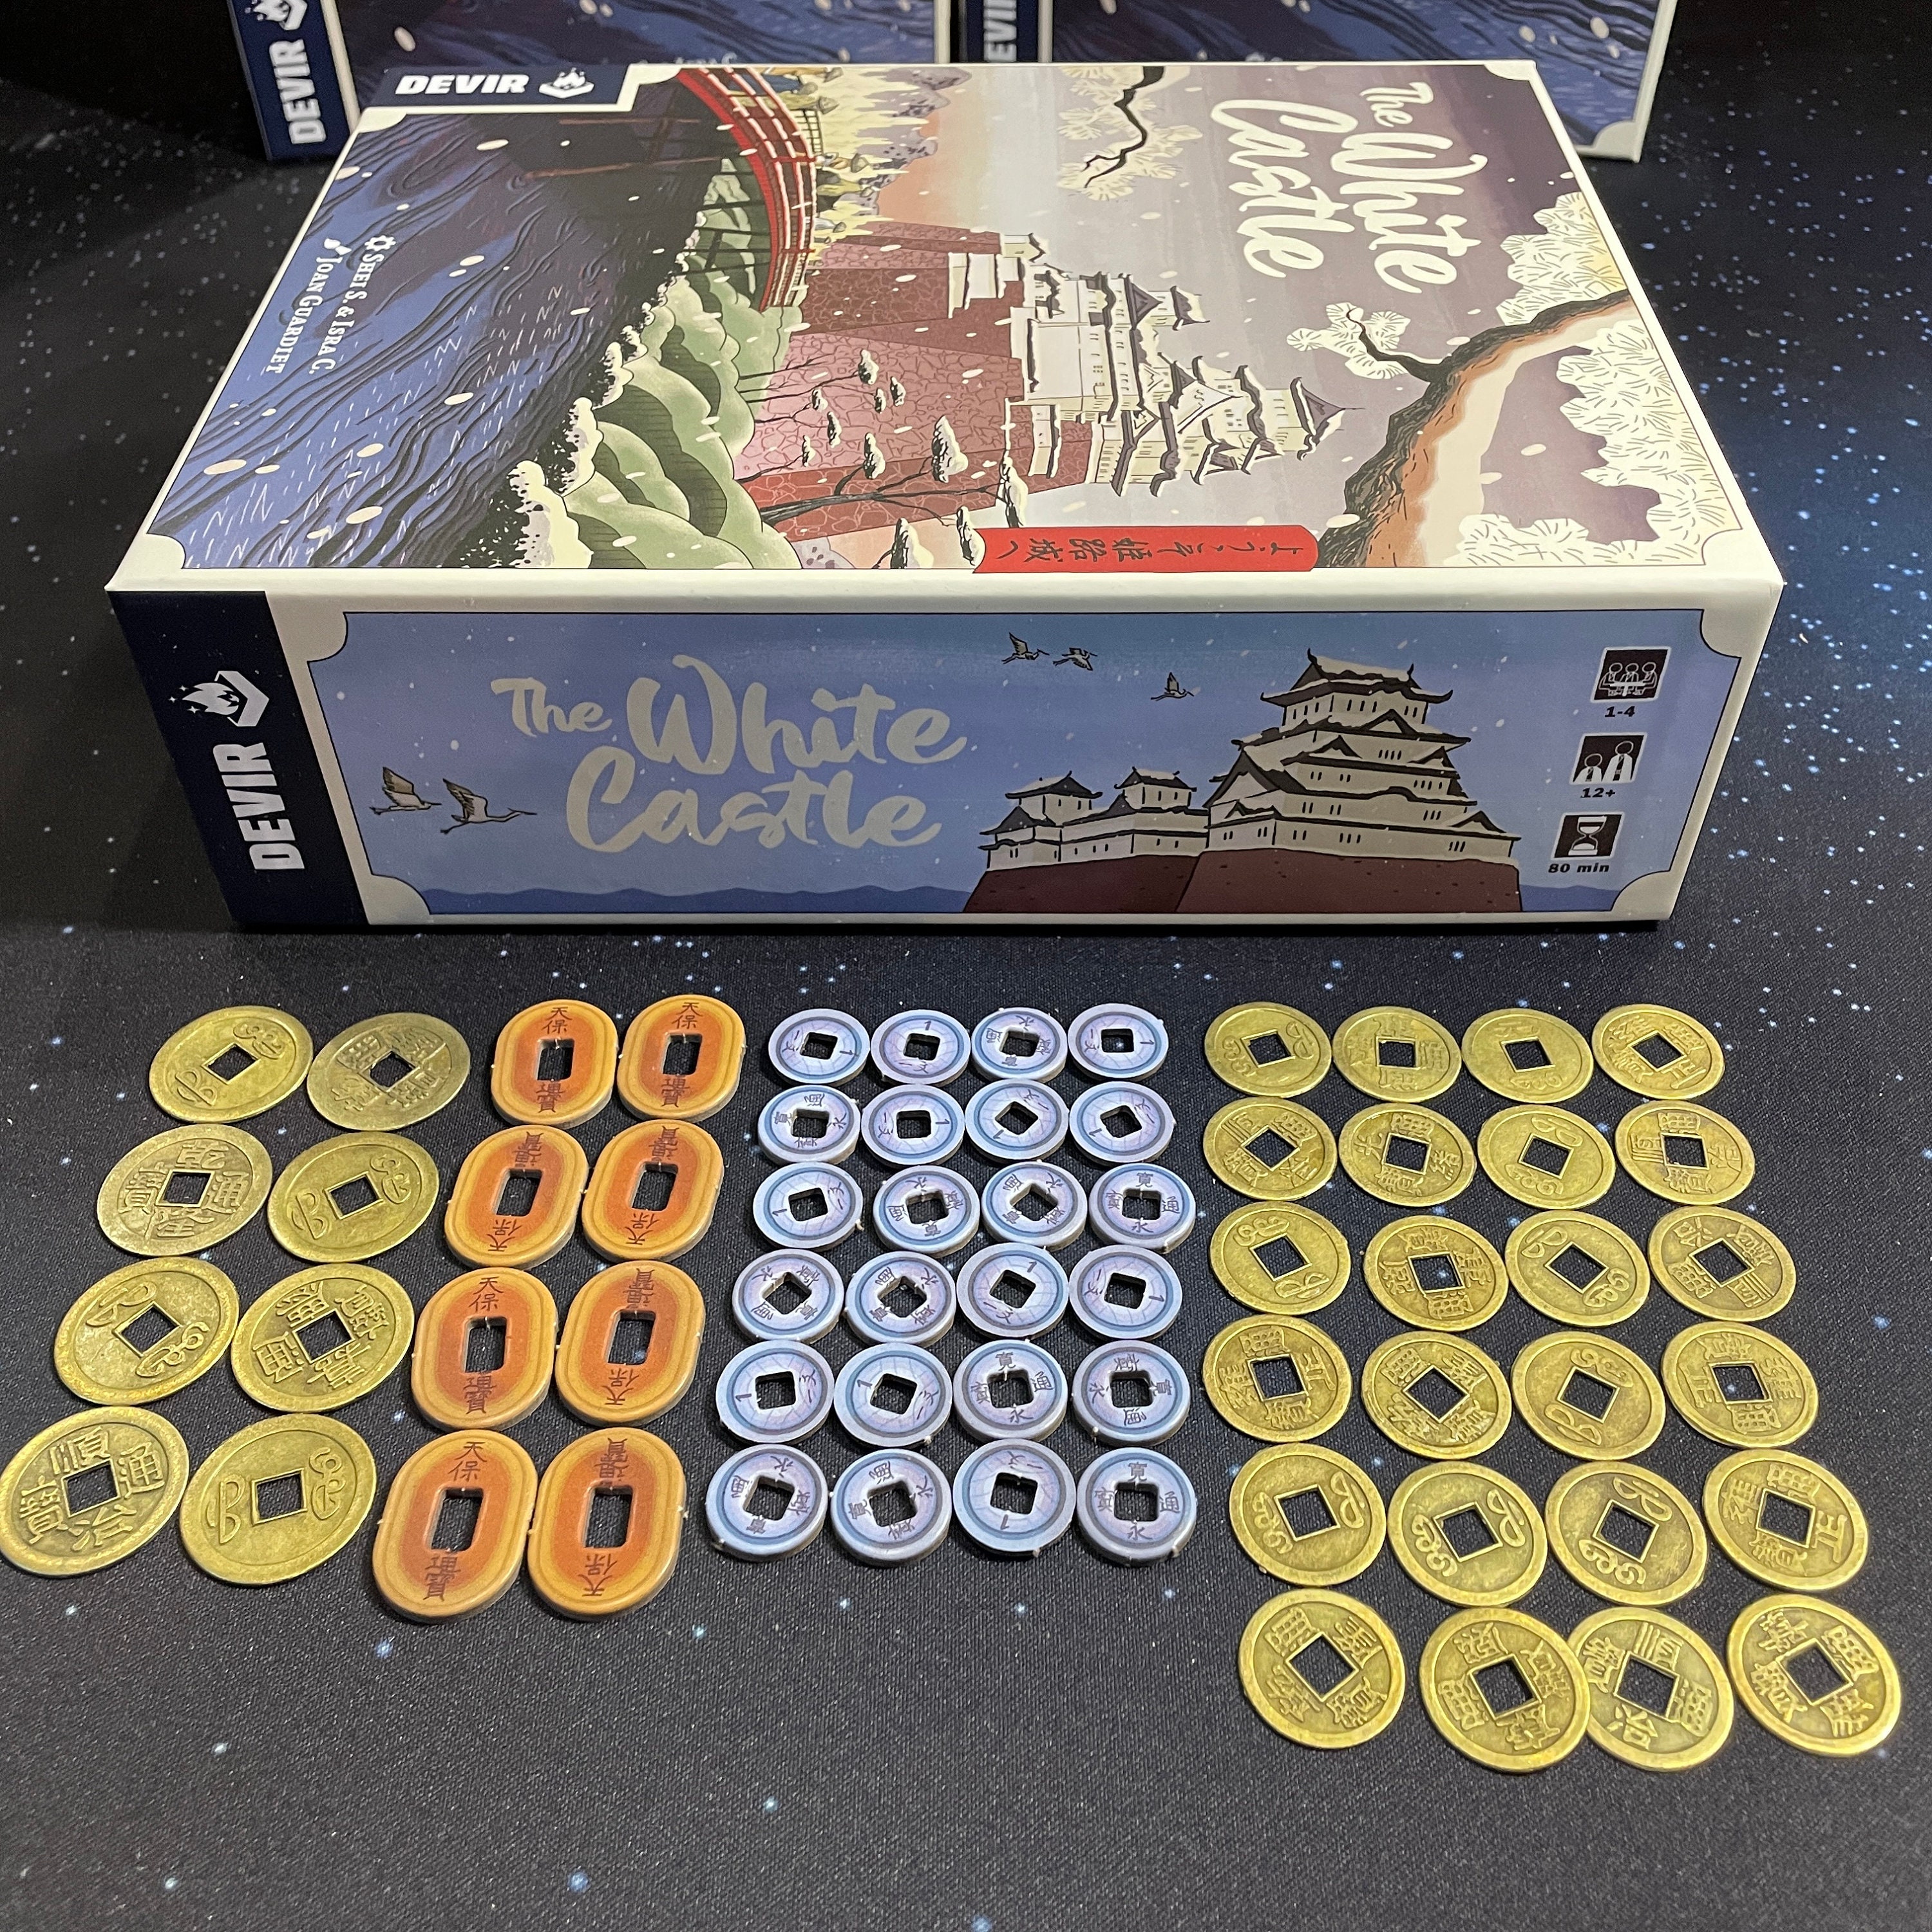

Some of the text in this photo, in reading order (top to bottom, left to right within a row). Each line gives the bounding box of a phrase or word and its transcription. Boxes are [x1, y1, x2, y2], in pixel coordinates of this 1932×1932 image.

[983, 0, 1018, 62] EVI
[269, 39, 327, 144] DEVIR
[395, 74, 530, 95] DEVIR
[1211, 99, 1359, 278] Castle
[1331, 82, 1488, 294] The White
[342, 290, 368, 304] S.
[335, 306, 355, 317] &
[308, 358, 337, 375] C.
[996, 536, 1304, 564] ようこそ姫路城へ
[489, 654, 967, 775] The White
[1604, 706, 1636, 717] 1-4
[213, 742, 305, 870] DEVIR
[565, 745, 943, 853] Castle
[1580, 788, 1616, 799] 12+
[1548, 862, 1609, 873] 80 min
